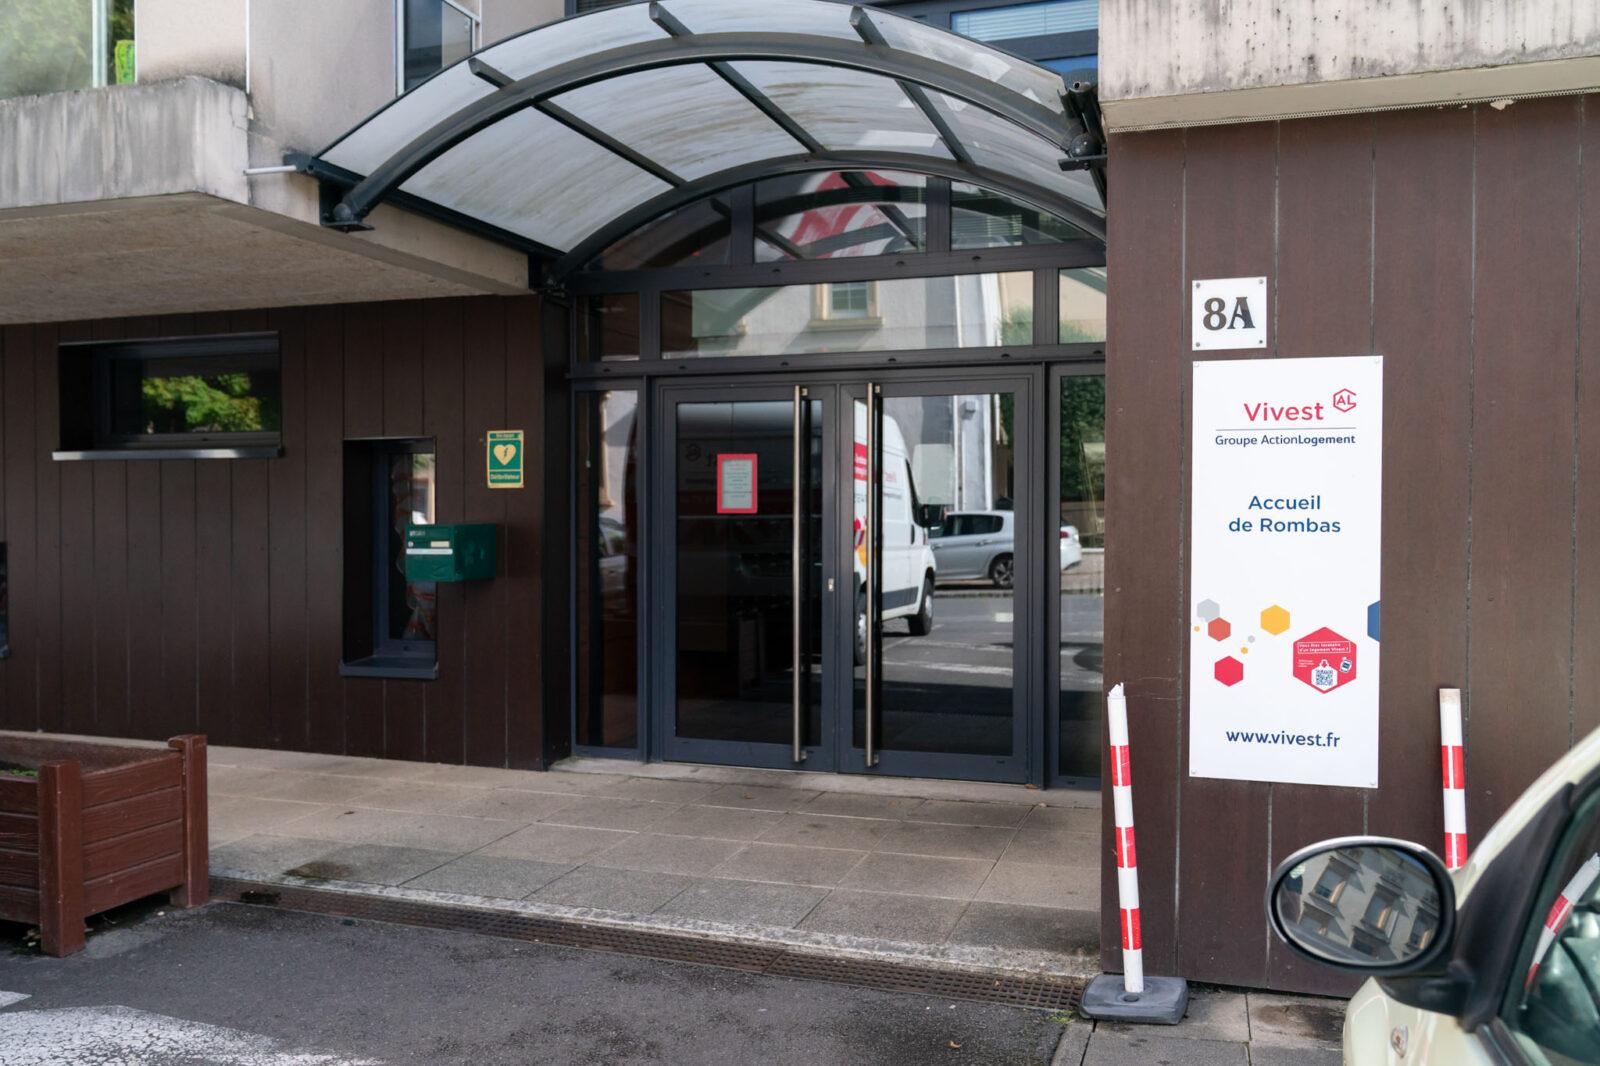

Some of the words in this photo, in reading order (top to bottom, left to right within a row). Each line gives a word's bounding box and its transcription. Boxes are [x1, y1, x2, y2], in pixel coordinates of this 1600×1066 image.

[1203, 296, 1255, 330] 8A
[1243, 402, 1324, 421] Vivest
[1214, 434, 1258, 448] Groupe
[1260, 432, 1356, 448] ActionLogement
[1248, 495, 1321, 510] Accueil
[1229, 518, 1253, 533] de
[1259, 517, 1341, 533] Rombas
[1225, 730, 1341, 748] www.vivest.fr
